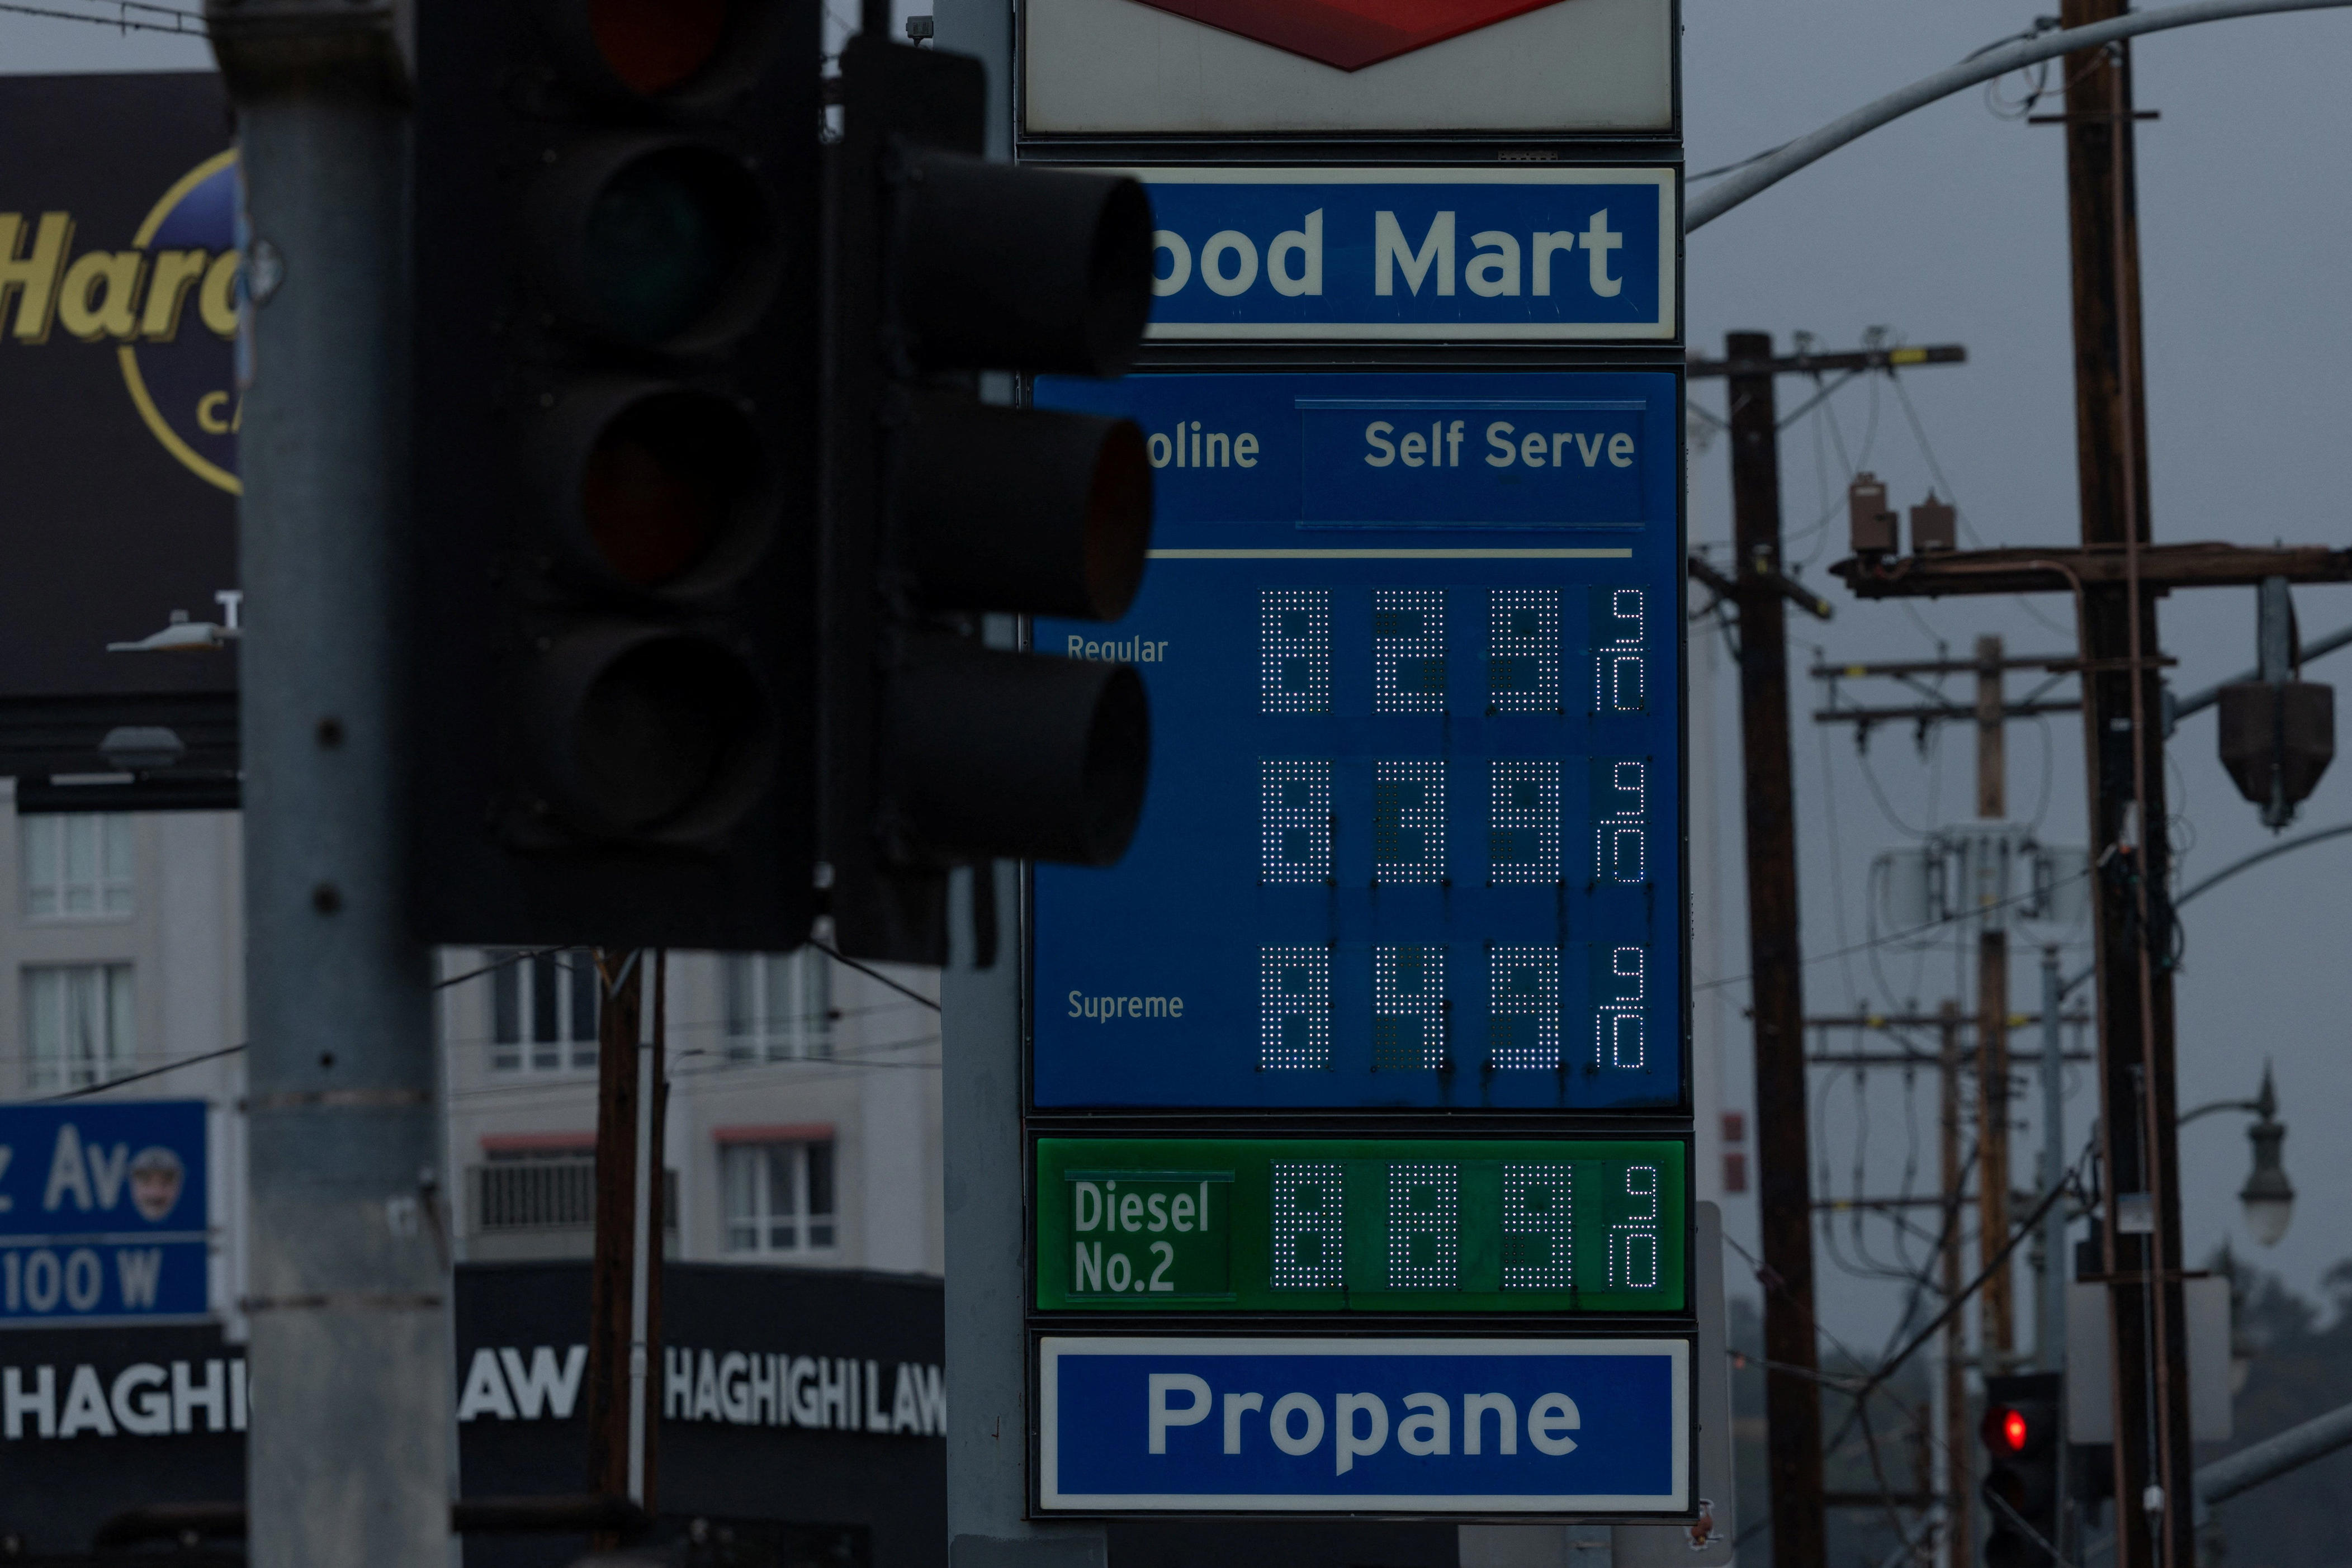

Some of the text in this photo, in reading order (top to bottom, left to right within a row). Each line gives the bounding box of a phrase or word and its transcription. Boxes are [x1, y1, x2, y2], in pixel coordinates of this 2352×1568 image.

[1150, 207, 1623, 298] ood Mart
[1146, 420, 1260, 468] oline
[1364, 420, 1635, 468] Self Serve
[1068, 634, 1169, 664] Regular
[1067, 990, 1184, 1024] Supreme
[1075, 1180, 1209, 1232] Diesel
[116, 1247, 163, 1311] W
[1075, 1241, 1175, 1292] No.2
[3, 1344, 589, 1441] HAGHI AW
[1148, 1372, 1582, 1476] Propane
